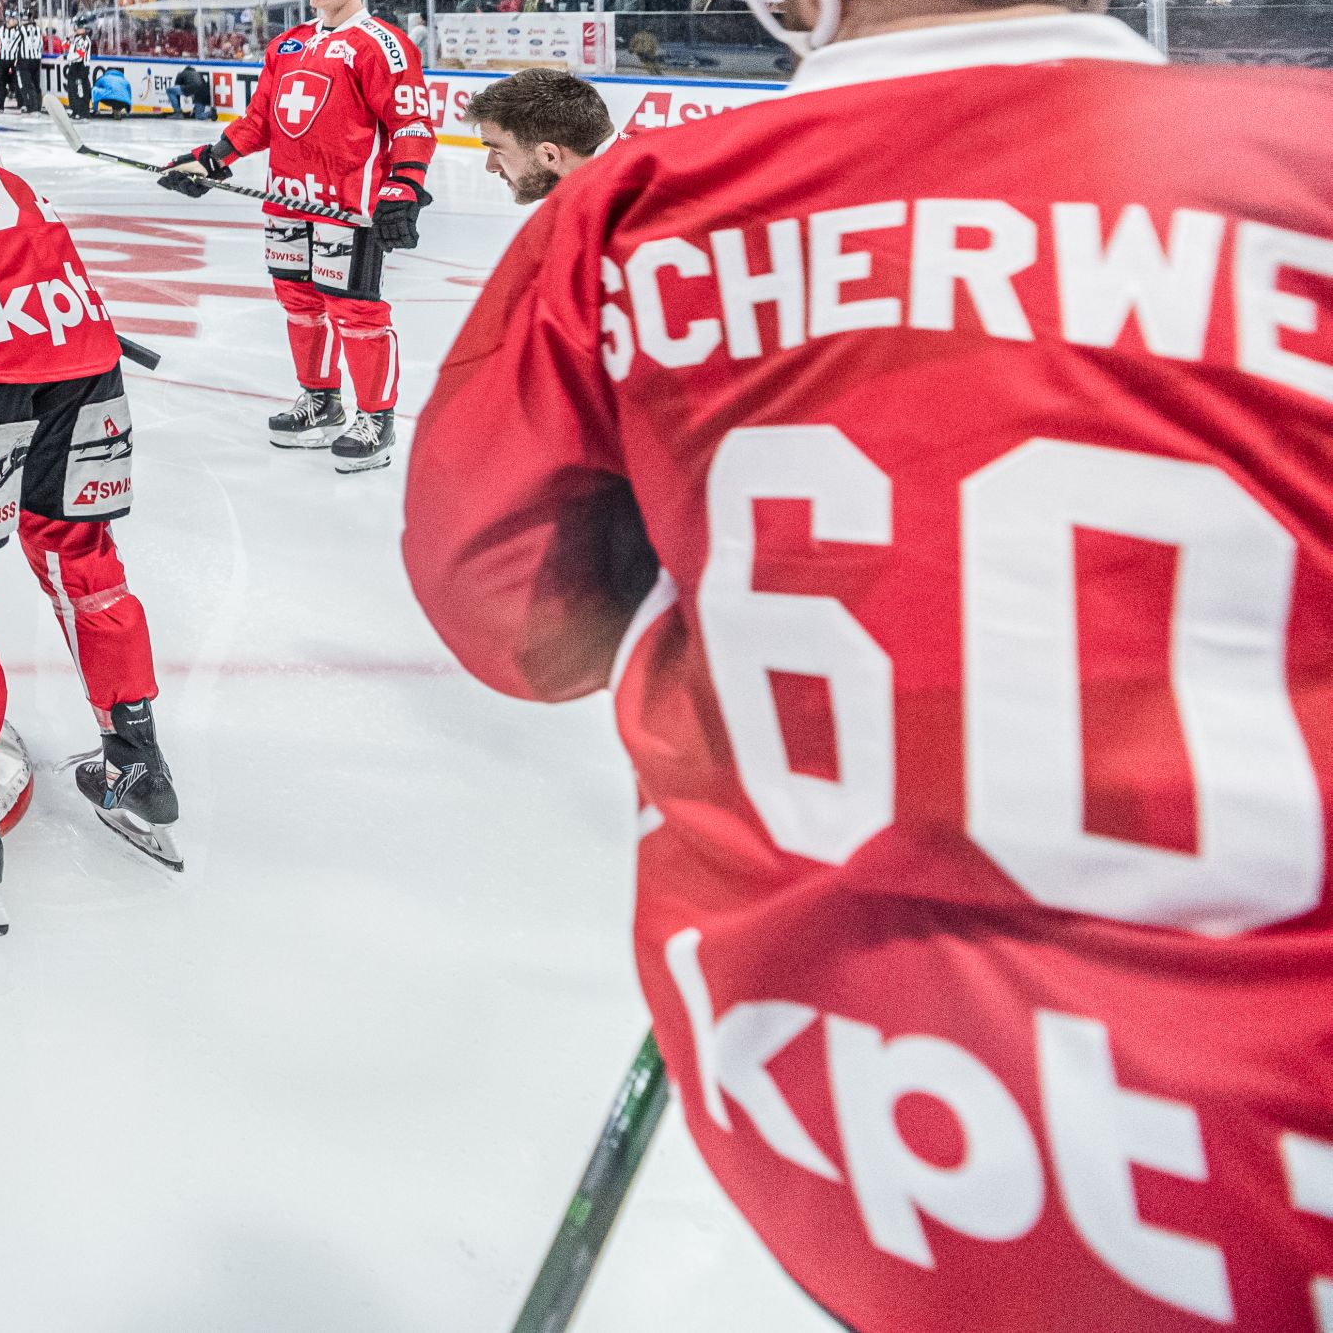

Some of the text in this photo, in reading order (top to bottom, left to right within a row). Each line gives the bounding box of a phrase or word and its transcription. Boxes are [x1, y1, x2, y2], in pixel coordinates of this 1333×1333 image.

[394, 84, 432, 117] 95
[270, 250, 304, 263] SWISS
[313, 265, 344, 281] SWISS
[601, 198, 1333, 404] SCHERWE
[99, 479, 132, 500] SWIS
[697, 424, 1325, 938] 60
